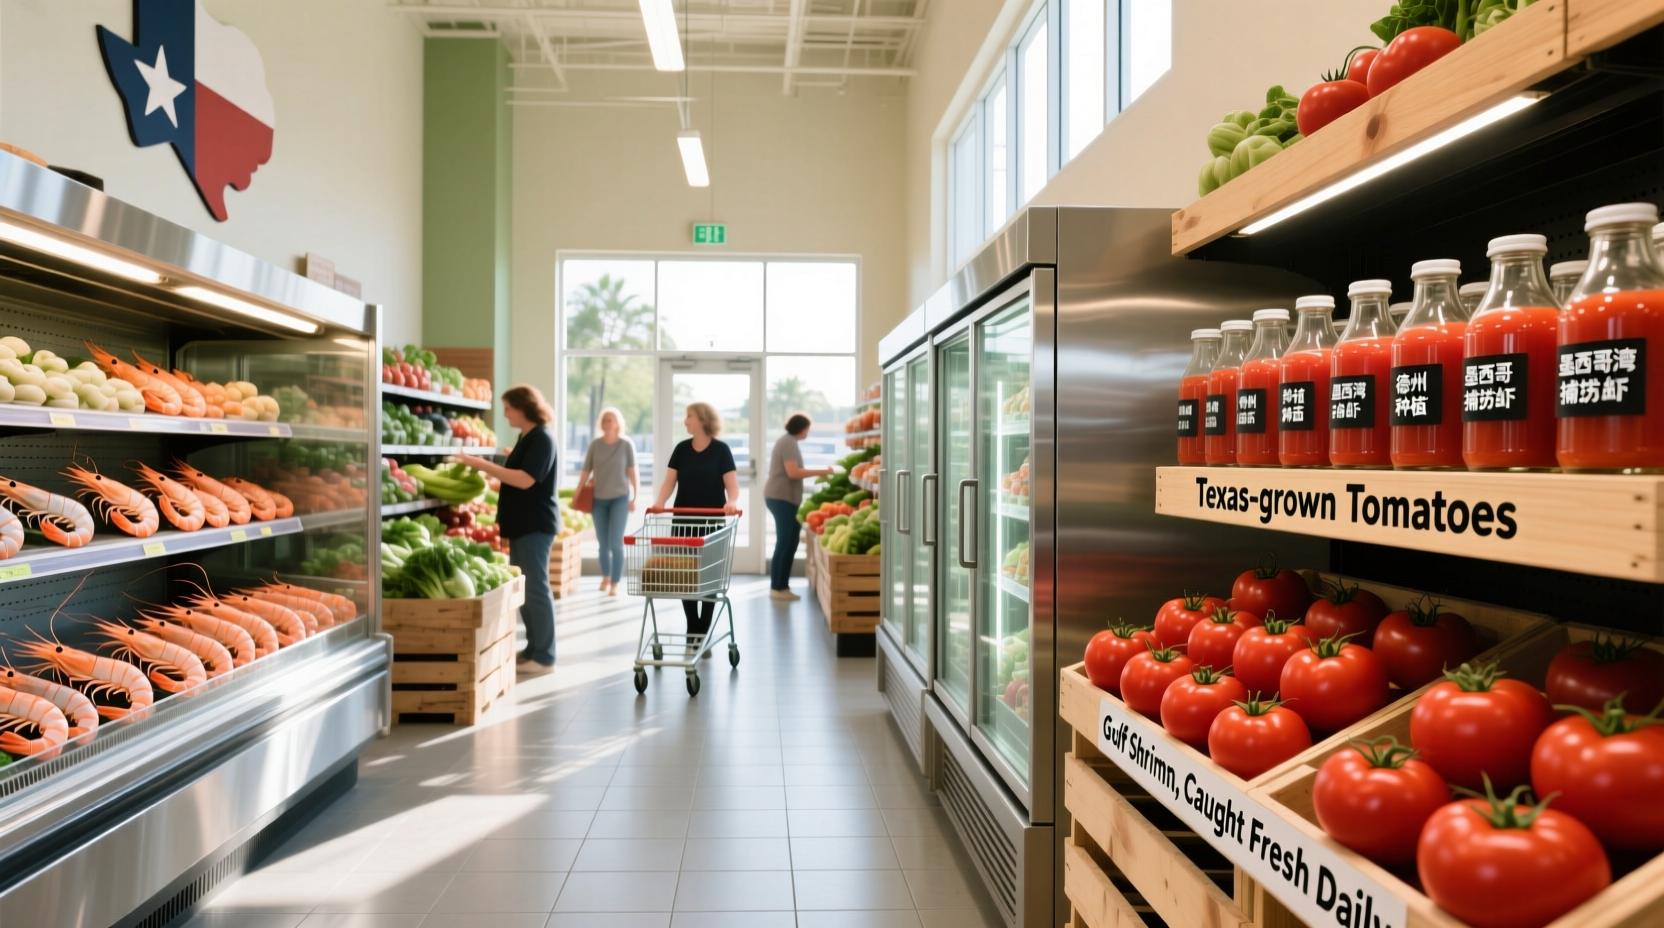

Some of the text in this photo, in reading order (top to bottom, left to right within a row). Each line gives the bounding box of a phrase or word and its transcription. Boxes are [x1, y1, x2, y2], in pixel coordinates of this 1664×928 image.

[1196, 477, 1518, 540] Texas-grown Tomatoes
[1184, 772, 1245, 845] Caught
[1249, 817, 1309, 895] Fresh
